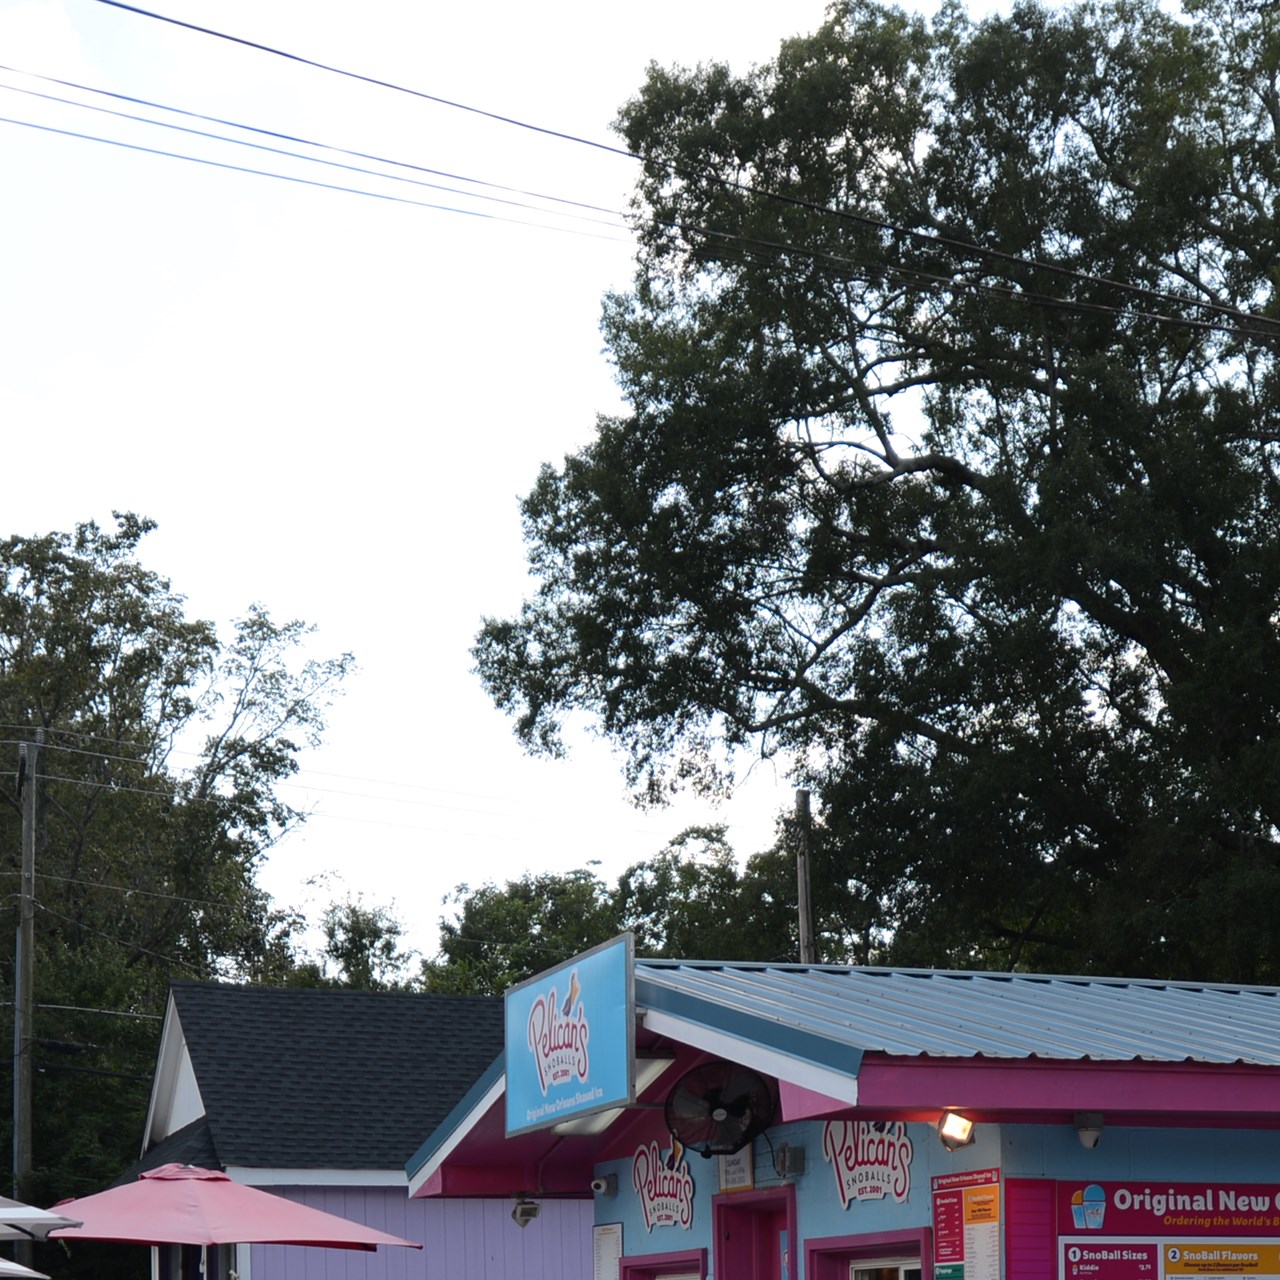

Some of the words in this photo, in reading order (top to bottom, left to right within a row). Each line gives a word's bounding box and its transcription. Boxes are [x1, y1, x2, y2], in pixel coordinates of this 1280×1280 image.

[529, 992, 587, 1090] Pelican's
[544, 1055, 576, 1076] SNOBALLS
[824, 1120, 909, 1204] Pelican's
[634, 1146, 691, 1228] Pelican's
[847, 1171, 891, 1190] SNOBALLS
[858, 1187, 869, 1195] EST.
[870, 1186, 882, 1194] 2001
[649, 1205, 679, 1217] SNOBALLS
[1113, 1188, 1214, 1216] Original
[1218, 1190, 1270, 1212] New
[1163, 1215, 1210, 1228] Ordering
[1213, 1216, 1230, 1225] the
[1232, 1216, 1271, 1226] World's
[1082, 1250, 1121, 1260] SnoBall
[1122, 1250, 1148, 1260] Sizes
[1183, 1250, 1221, 1260] SnoBall
[1222, 1250, 1258, 1260] Flavors
